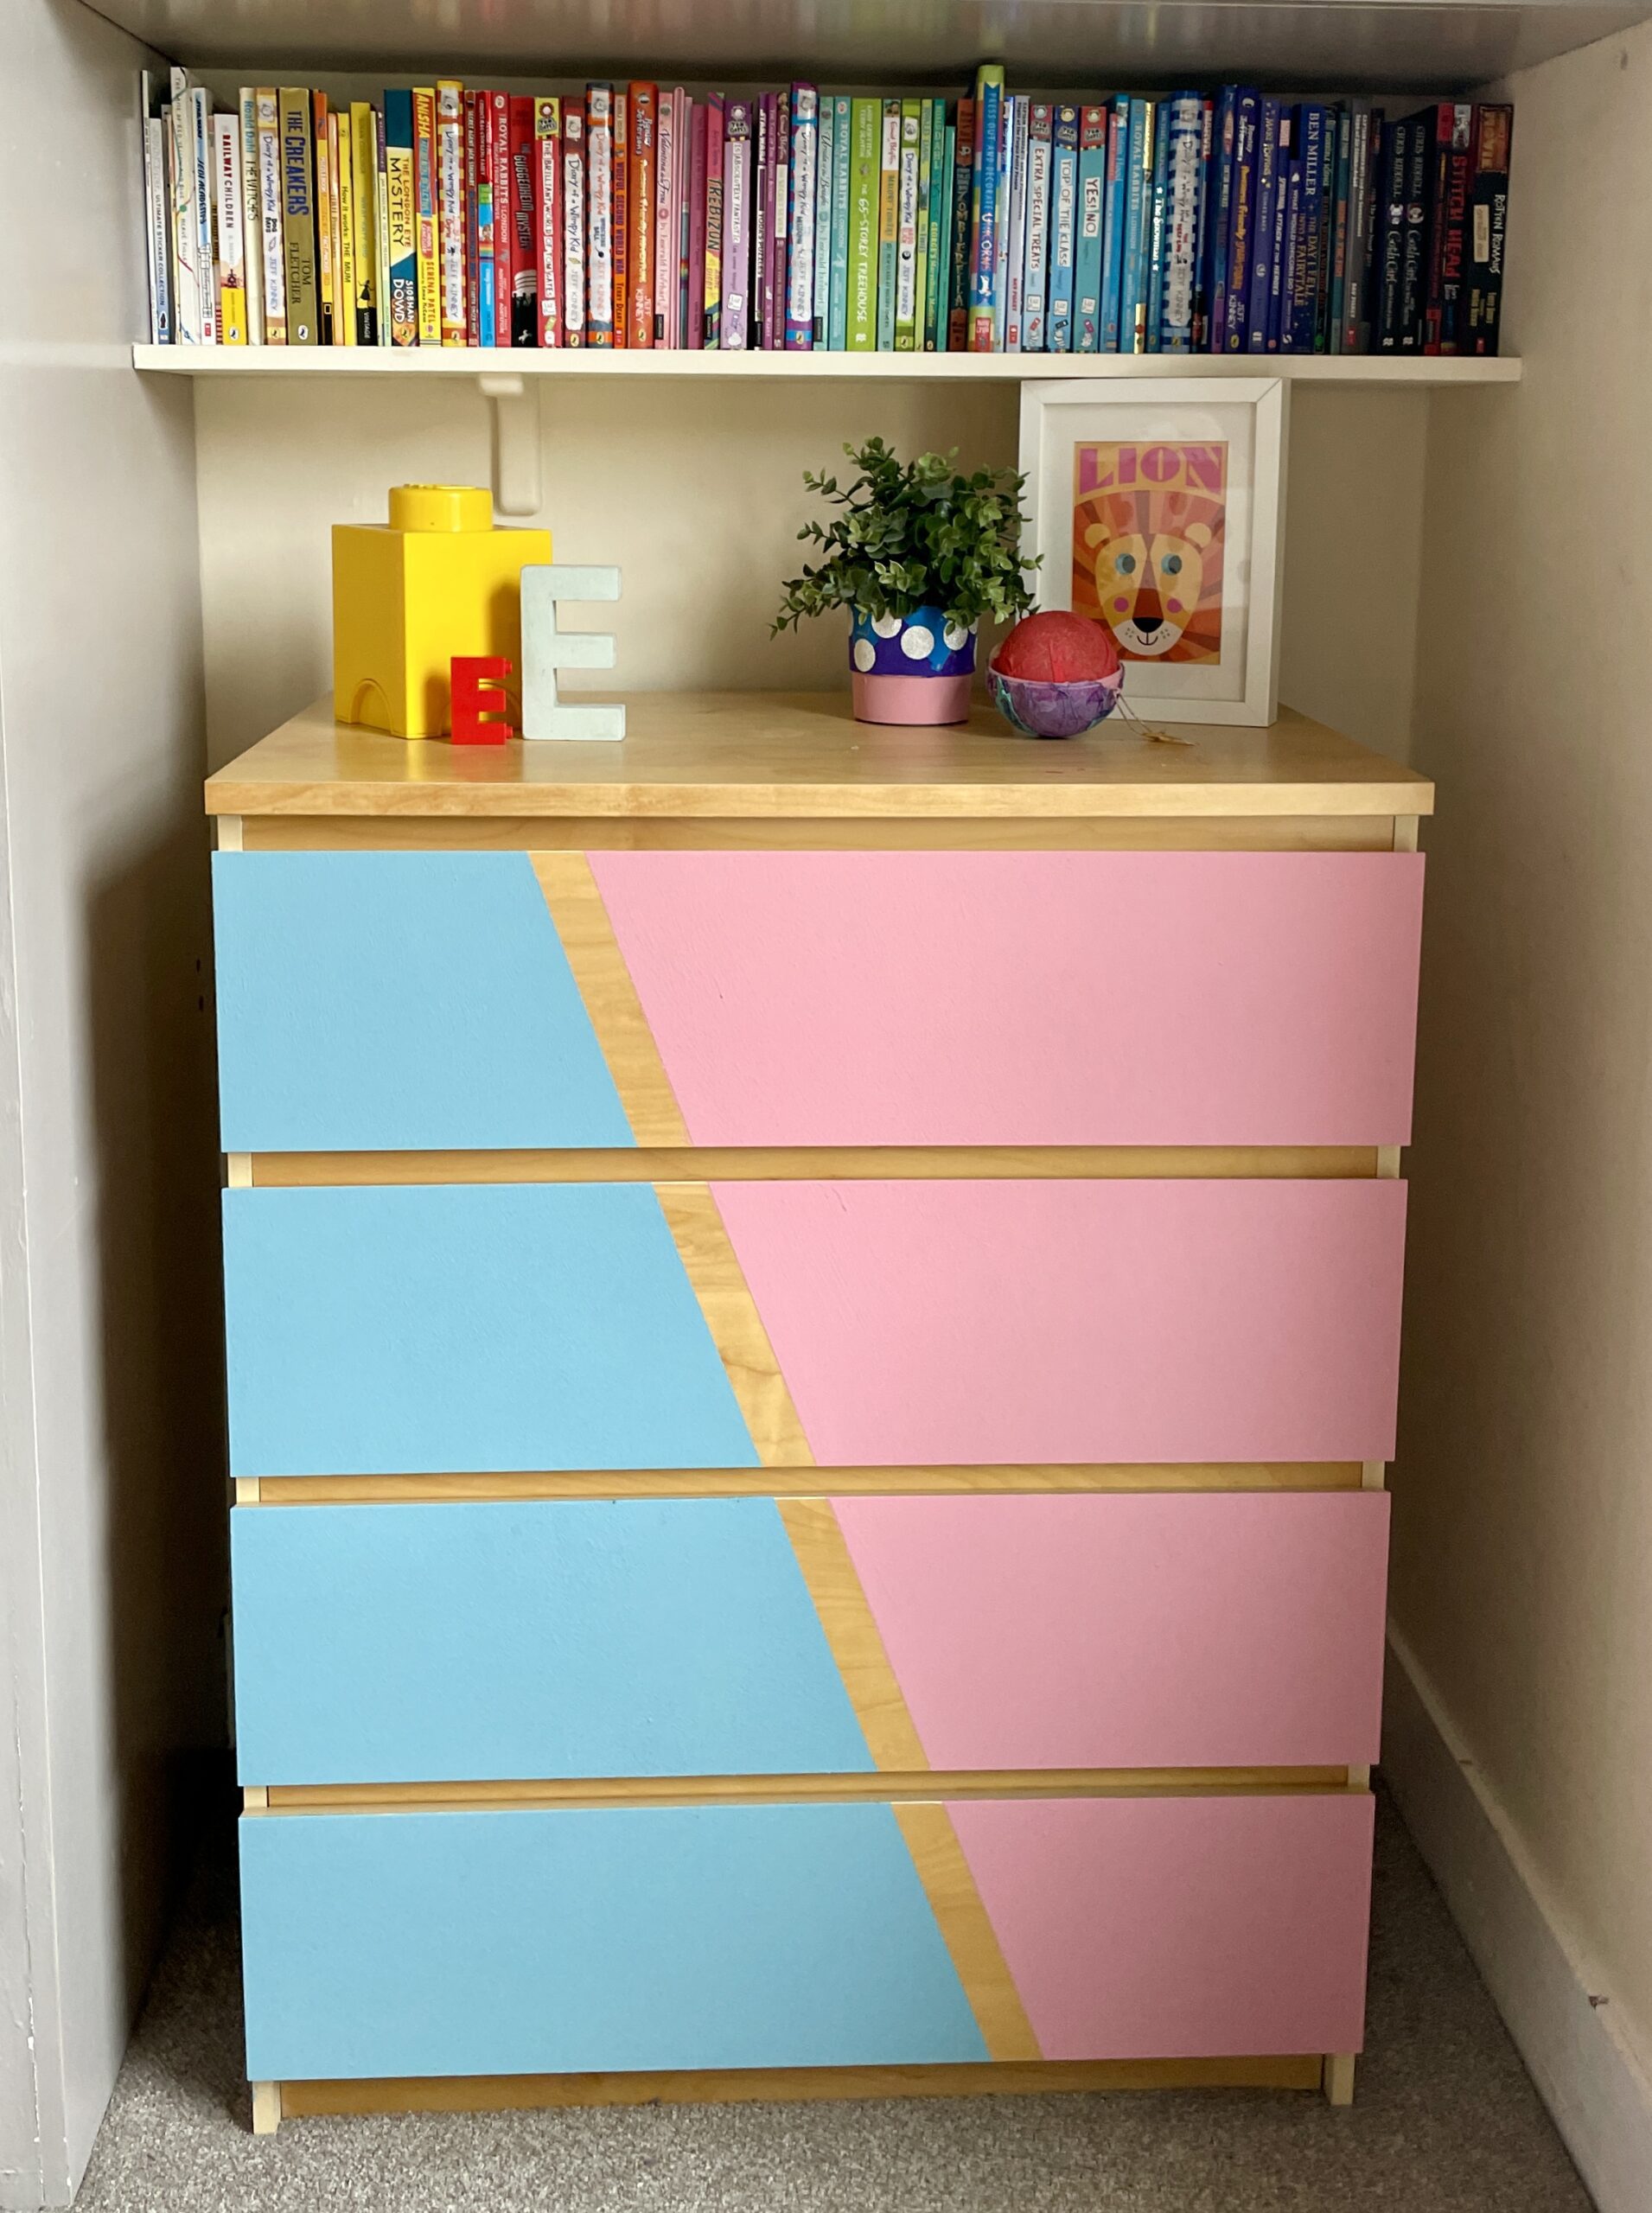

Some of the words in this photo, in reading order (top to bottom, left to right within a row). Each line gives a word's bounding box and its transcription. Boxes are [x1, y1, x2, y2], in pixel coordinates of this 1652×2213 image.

[244, 100, 254, 129] Roald
[416, 95, 431, 138] ANISHA
[988, 92, 997, 119] PRESS
[287, 111, 303, 132] THE
[1308, 112, 1320, 140] BEN
[246, 131, 255, 153] Dahl
[263, 136, 273, 158] Diary
[596, 133, 604, 156] Diary
[1133, 125, 1142, 160] ROYAL
[1396, 125, 1406, 154] CHRIS
[1415, 125, 1426, 154] CHRIS
[222, 135, 232, 177] RAILWAY
[905, 153, 914, 174] Diary
[1034, 148, 1044, 181] EXTRA
[1304, 145, 1317, 195] MILLER
[265, 173, 274, 198] Wimpy
[284, 137, 309, 215] CREAKERS
[513, 155, 534, 211] GUGGENHEIM
[568, 160, 579, 188] Diary
[595, 174, 603, 201] Wimpy
[616, 163, 624, 191] WOEFUL
[1062, 161, 1071, 183] TOP
[1132, 164, 1141, 210] RABBITS
[246, 179, 258, 220] WITCHES
[390, 158, 404, 246] MYSTERY
[903, 188, 912, 212] Wimpy
[985, 167, 994, 210] DECORATE
[1061, 188, 1070, 203] OF
[1087, 180, 1098, 208] YES!
[1447, 156, 1468, 220] STITCH
[225, 180, 233, 228] CHILDREN
[266, 200, 276, 211] Kid
[616, 195, 624, 226] SECOND
[708, 178, 723, 251] TREBIZON
[800, 201, 809, 214] Kid
[1032, 187, 1043, 227] SPECIAL
[1060, 210, 1069, 229] THE
[1155, 198, 1164, 216] The
[515, 212, 533, 251] MYSTERY
[568, 206, 579, 235] Wimpy
[858, 198, 869, 257] 65-STOREY
[1086, 214, 1096, 235] NO.
[1308, 216, 1317, 233] THE
[545, 238, 552, 248] OF
[570, 238, 580, 252] Kid
[616, 228, 624, 256] WORLD
[1031, 233, 1041, 270] TREATS
[1059, 233, 1068, 265] CLASS
[1152, 217, 1164, 260] Snowman
[1307, 236, 1317, 258] DAY
[1387, 230, 1401, 258] Goth
[1406, 230, 1421, 258] Goth
[616, 258, 624, 274] WAR
[1288, 242, 1297, 277] UNICORN
[1489, 233, 1503, 276] ROMANS
[290, 242, 301, 304] FLETCHER
[302, 258, 311, 285] TOM
[426, 261, 435, 294] SERENA
[1294, 245, 1306, 306] FAIRYTALE
[1305, 271, 1317, 298] FELL
[393, 279, 405, 322] DOWD
[405, 280, 414, 322] SIOBHAN
[571, 291, 579, 322] KINNEY
[635, 289, 644, 323] KINNEY
[857, 262, 867, 322] TREEHOUSE
[1176, 290, 1185, 322] KINNEY
[1228, 294, 1236, 329] KINNEY
[1080, 447, 1222, 496] LION
[521, 564, 626, 741] E
[450, 657, 513, 745] E
